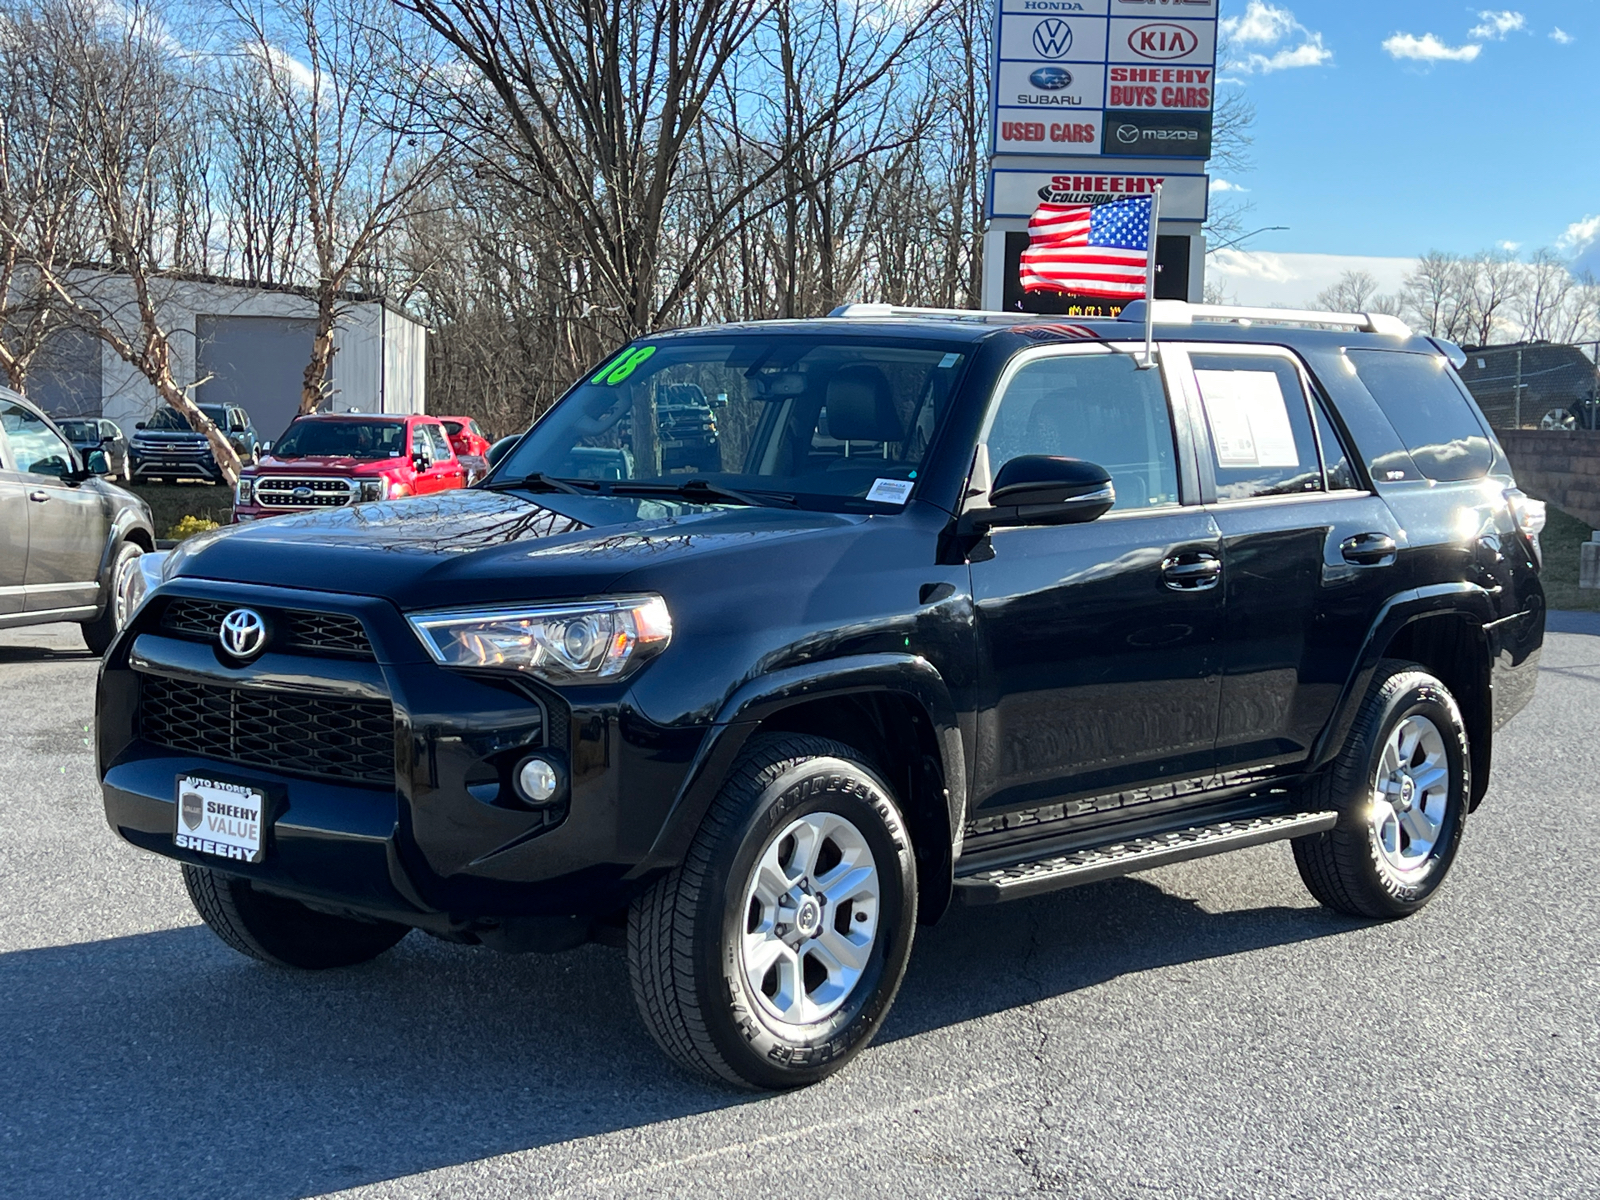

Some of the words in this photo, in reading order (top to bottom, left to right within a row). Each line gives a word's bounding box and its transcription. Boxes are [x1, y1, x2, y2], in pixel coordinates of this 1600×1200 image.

[1024, 1, 1084, 11] HONDA
[1140, 31, 1185, 52] KIA
[1110, 68, 1211, 84] SHEEHY
[1017, 94, 1082, 106] SUBARU
[1110, 85, 1157, 107] BUYS
[1161, 86, 1210, 108] CARS
[1001, 121, 1046, 142] USED
[1050, 123, 1095, 143] CARS
[1142, 128, 1198, 141] mazda
[1051, 176, 1165, 193] SHEEHY
[1051, 192, 1114, 204] COLLISION
[591, 346, 656, 385] 18
[186, 776, 211, 789] AUTO
[214, 782, 253, 796] STORES
[207, 801, 258, 821] SHEEHY
[207, 816, 258, 840] VALUE
[176, 835, 257, 862] SHEEHY
